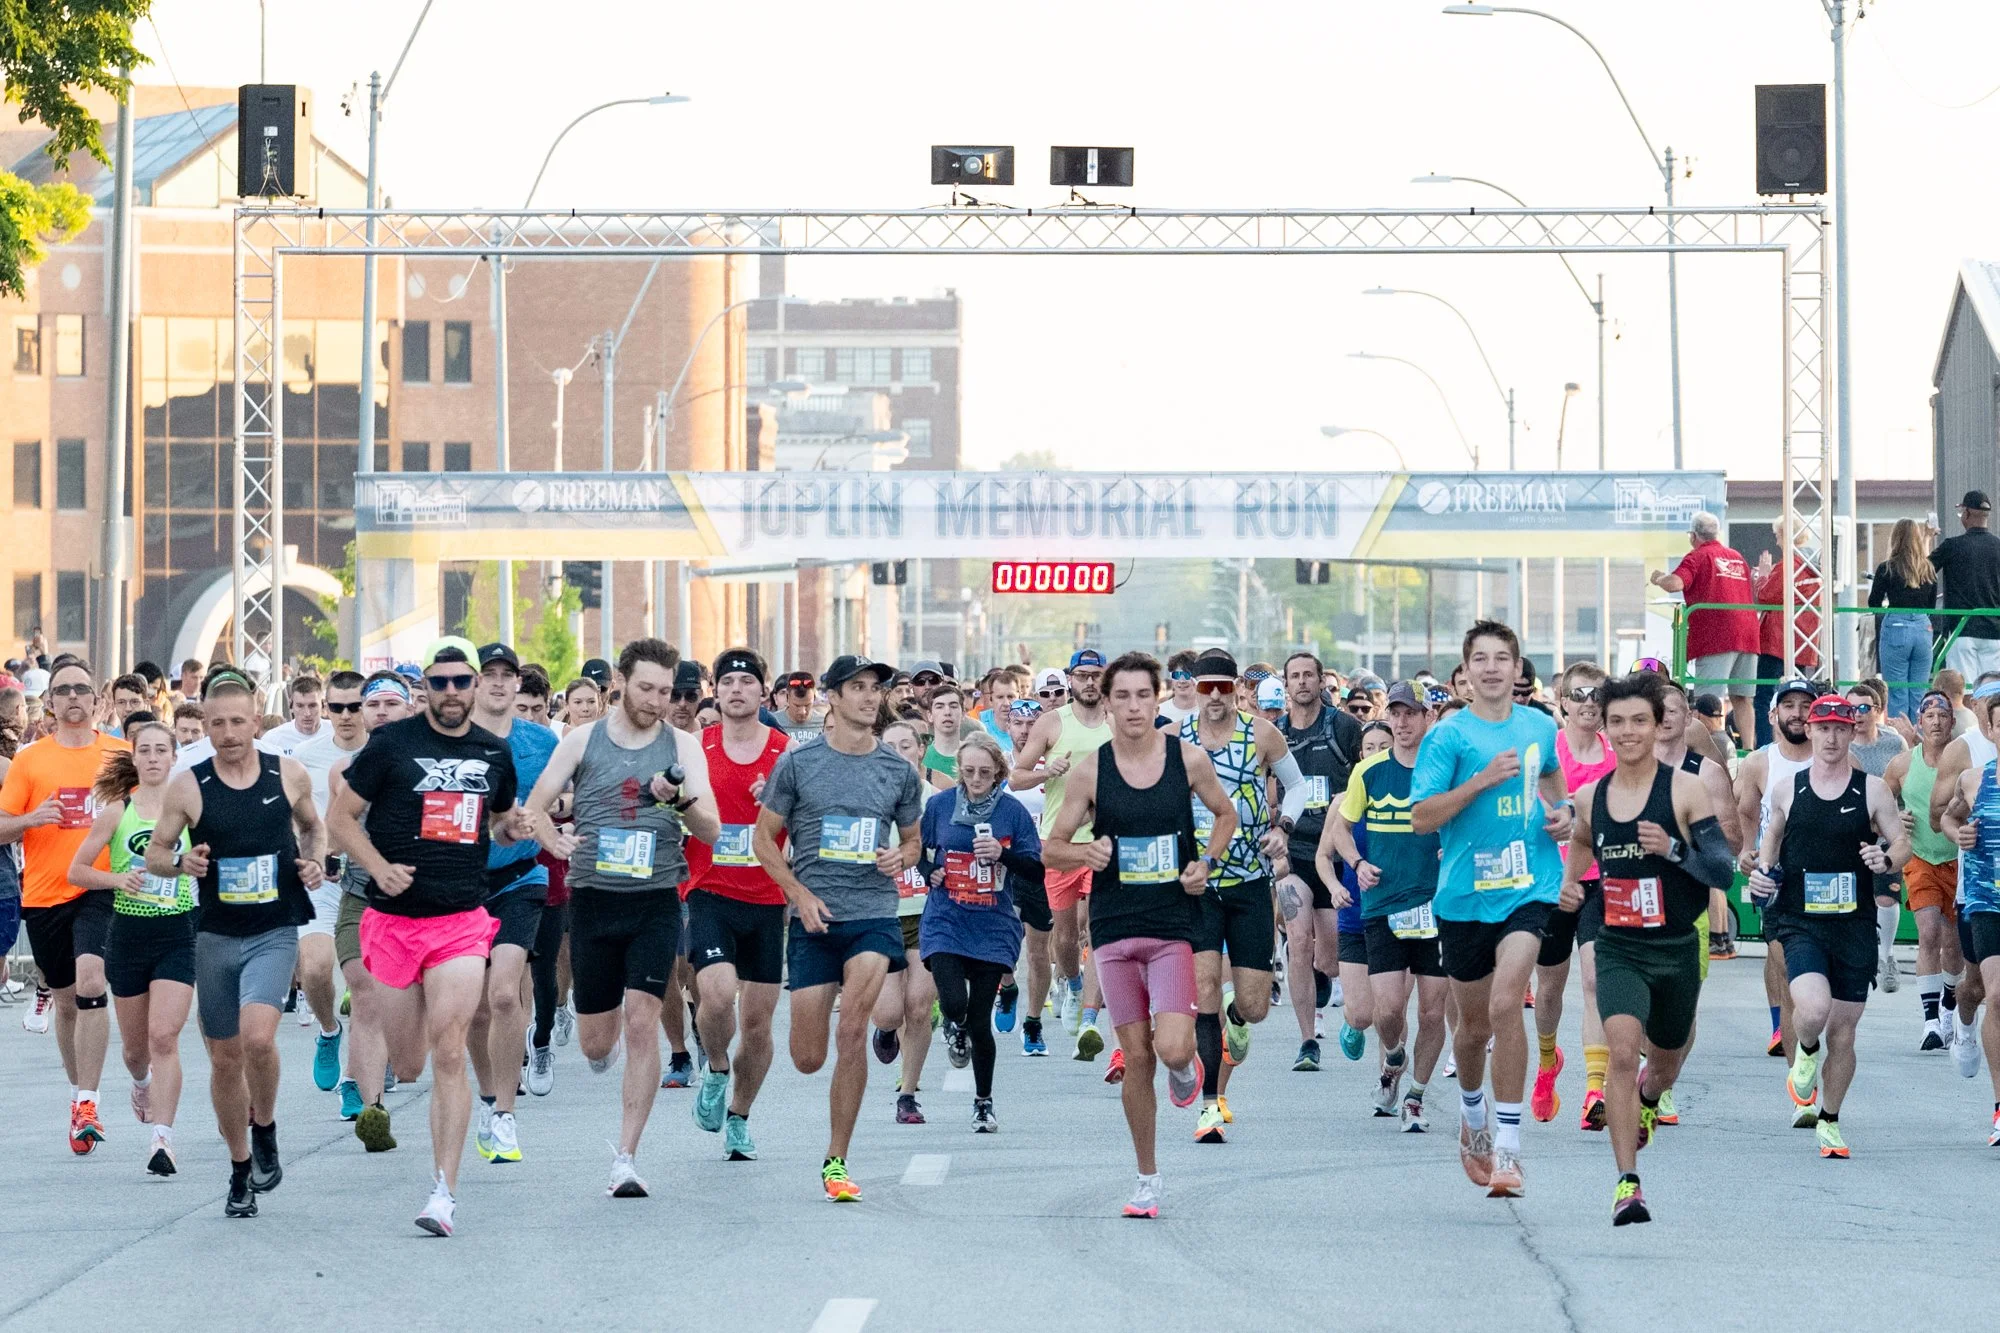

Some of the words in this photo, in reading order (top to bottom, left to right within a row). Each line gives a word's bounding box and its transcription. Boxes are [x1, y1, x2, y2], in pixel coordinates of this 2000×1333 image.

[547, 481, 660, 511] FREEMAN
[1453, 482, 1568, 513] FREEMAN
[738, 479, 903, 550] JOPLIN
[933, 479, 1205, 541] MEMORIAL
[1232, 479, 1341, 541] RUN
[1508, 514, 1536, 524] Health
[1538, 515, 1568, 526] System
[1497, 796, 1522, 818] 13.1
[1643, 883, 1655, 916] 2148
